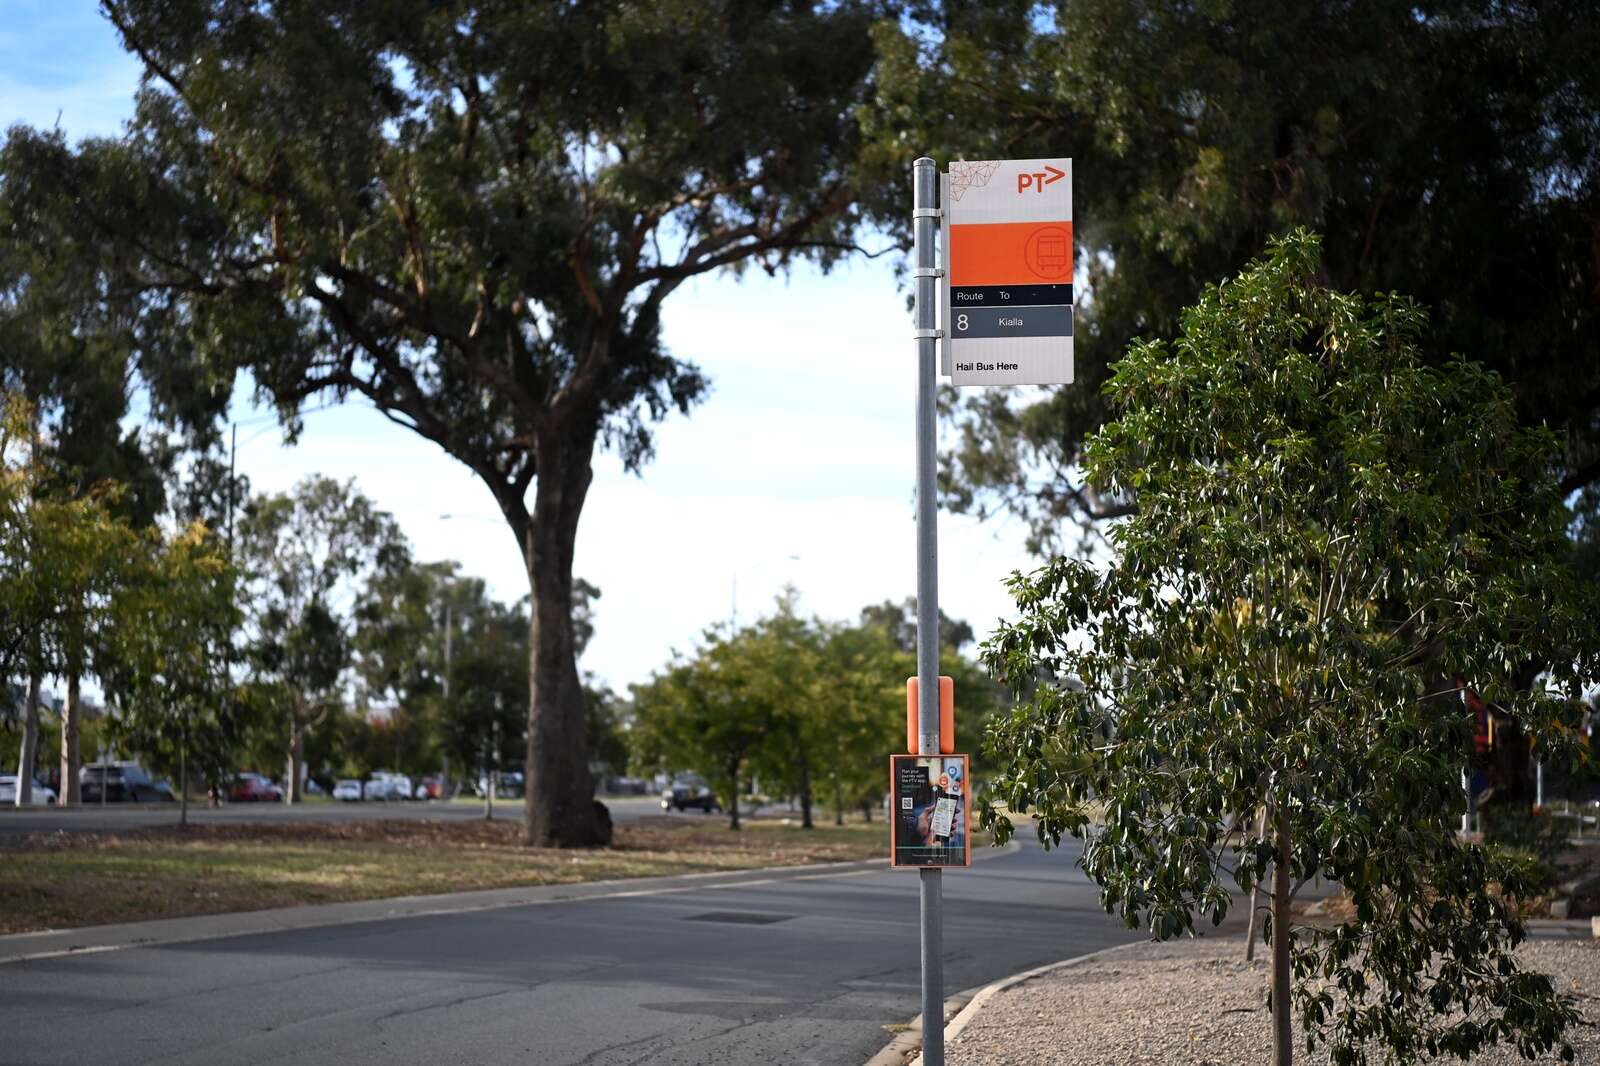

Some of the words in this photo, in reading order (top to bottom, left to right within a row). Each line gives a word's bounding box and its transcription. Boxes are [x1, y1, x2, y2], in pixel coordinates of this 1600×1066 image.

[957, 292, 984, 300] Route
[1000, 291, 1010, 300] To
[957, 314, 969, 331] 8
[998, 318, 1023, 326] Kialla
[956, 363, 974, 371] Hail
[976, 362, 994, 371] Bus
[997, 362, 1019, 370] Here
